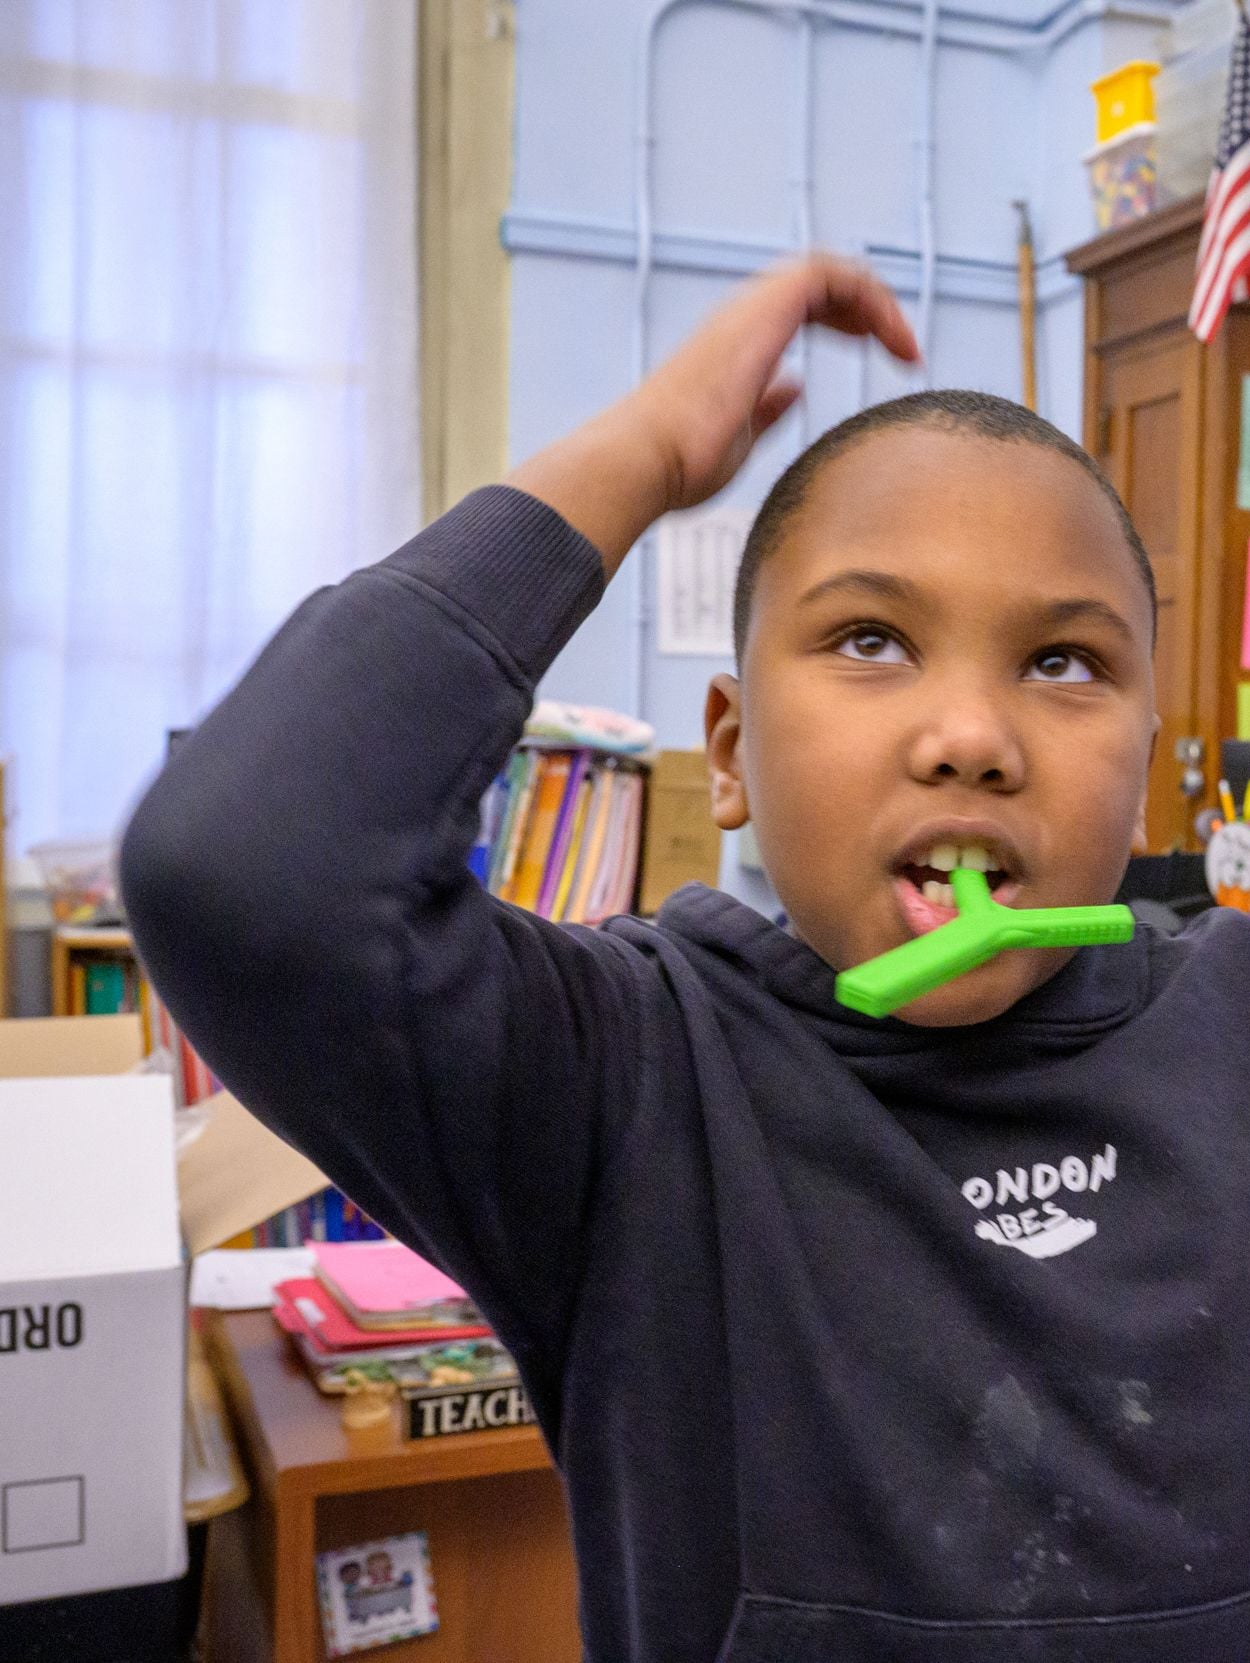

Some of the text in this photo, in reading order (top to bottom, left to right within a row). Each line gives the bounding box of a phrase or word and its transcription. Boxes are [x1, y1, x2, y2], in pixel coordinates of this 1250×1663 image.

[961, 1143, 1118, 1210] ONDON
[0, 1303, 83, 1353] ORD
[418, 1387, 538, 1437] TEACH
